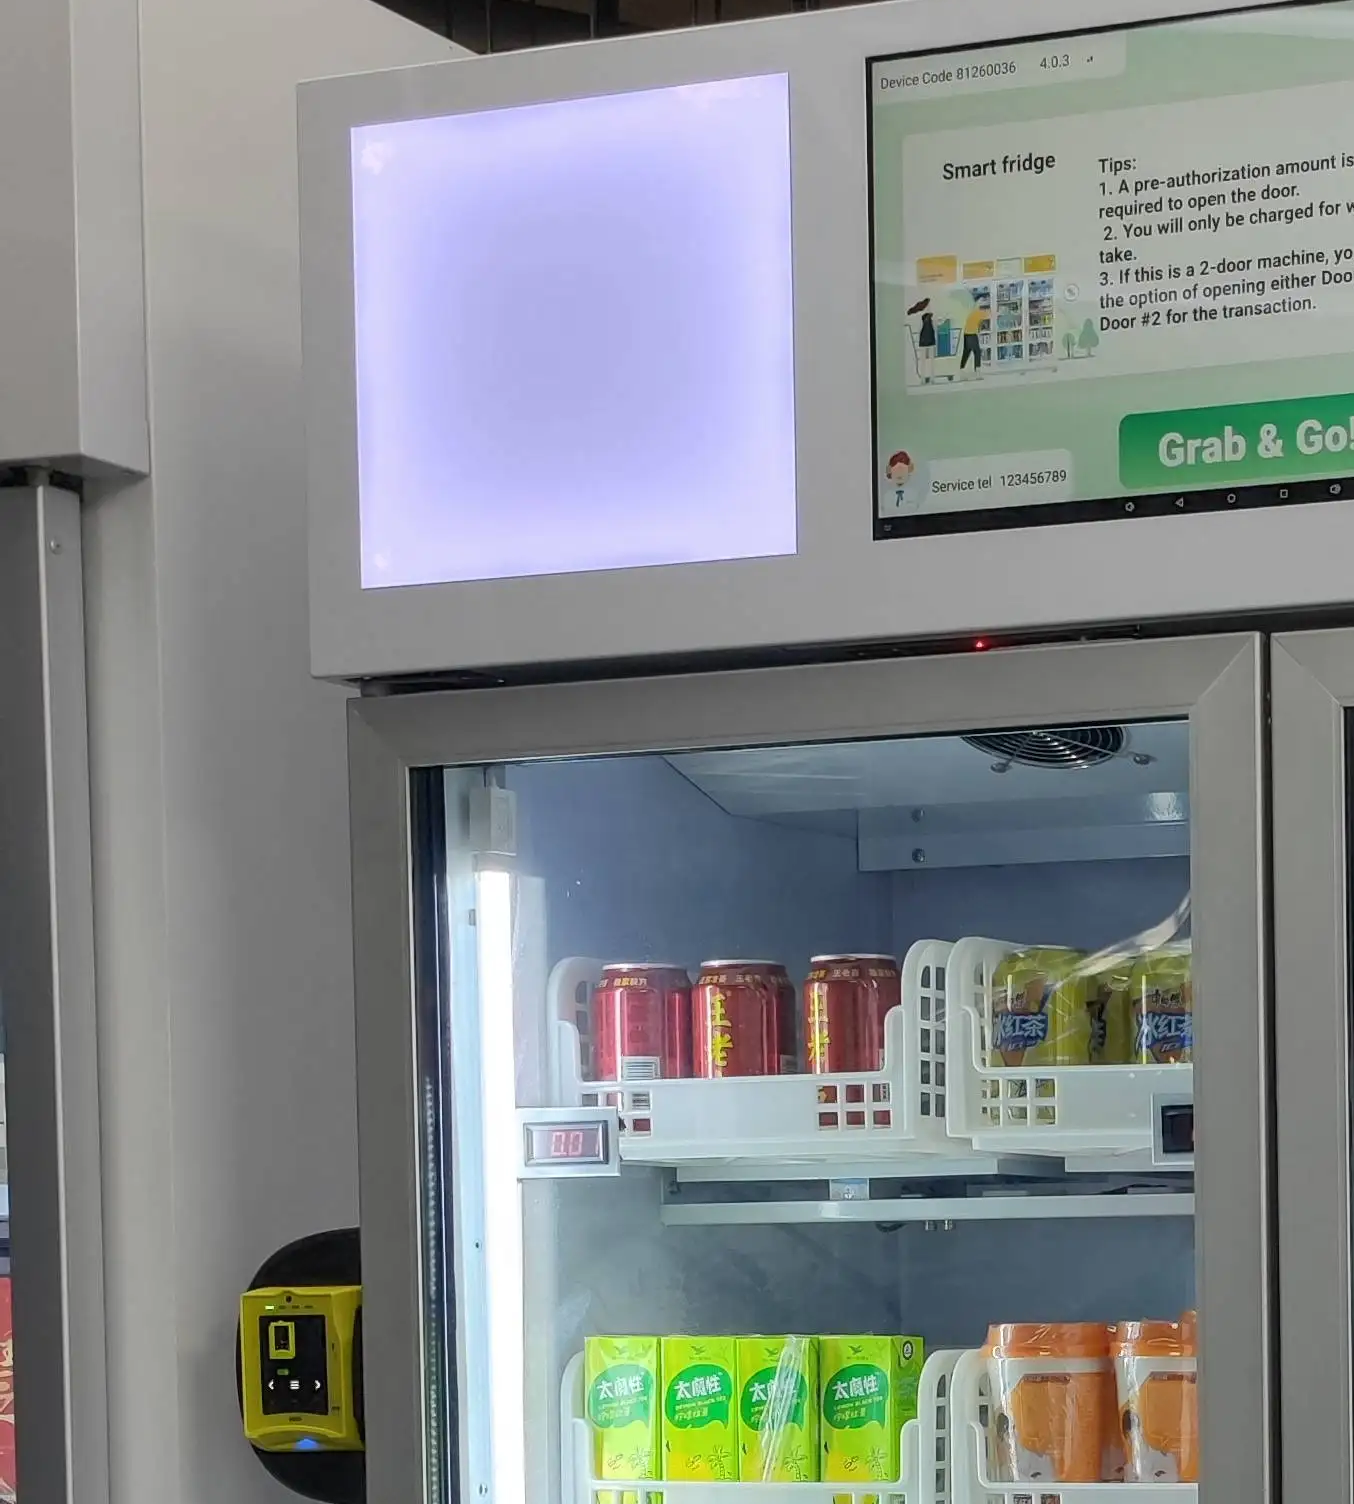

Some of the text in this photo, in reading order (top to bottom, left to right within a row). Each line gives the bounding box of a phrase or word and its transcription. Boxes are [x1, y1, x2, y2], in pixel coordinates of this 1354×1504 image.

[880, 54, 1071, 90] Device Code 81260036 4.0.3
[942, 152, 1056, 180] Smart fridge
[1098, 157, 1137, 176] Tips:
[1100, 152, 1354, 196] 1. A pre-authorization amount is
[1099, 184, 1300, 220] required to open the door.
[1103, 226, 1118, 241] 2.
[1123, 223, 1152, 239] You
[1157, 217, 1183, 235] will
[1188, 214, 1220, 232] only
[1225, 212, 1245, 227] be
[1249, 203, 1314, 224] charged
[1319, 201, 1341, 216] for
[1099, 247, 1137, 264] take.
[1100, 272, 1113, 286] 3.
[1119, 268, 1130, 284] If
[1134, 265, 1163, 283] this
[1168, 264, 1181, 279] is
[1185, 265, 1195, 278] a
[1200, 258, 1252, 276] 2-door
[1257, 250, 1329, 270] machine,
[1100, 293, 1124, 309] the
[1129, 289, 1177, 309] option
[1182, 283, 1199, 300] of
[1203, 279, 1265, 300] opening
[1271, 274, 1316, 291] either
[1100, 296, 1317, 331] Door #2 for the transaction.
[1158, 425, 1247, 468] Grab
[1257, 423, 1284, 459] &
[931, 469, 1067, 495] Service tel 123456789
[711, 992, 734, 1068] 王老
